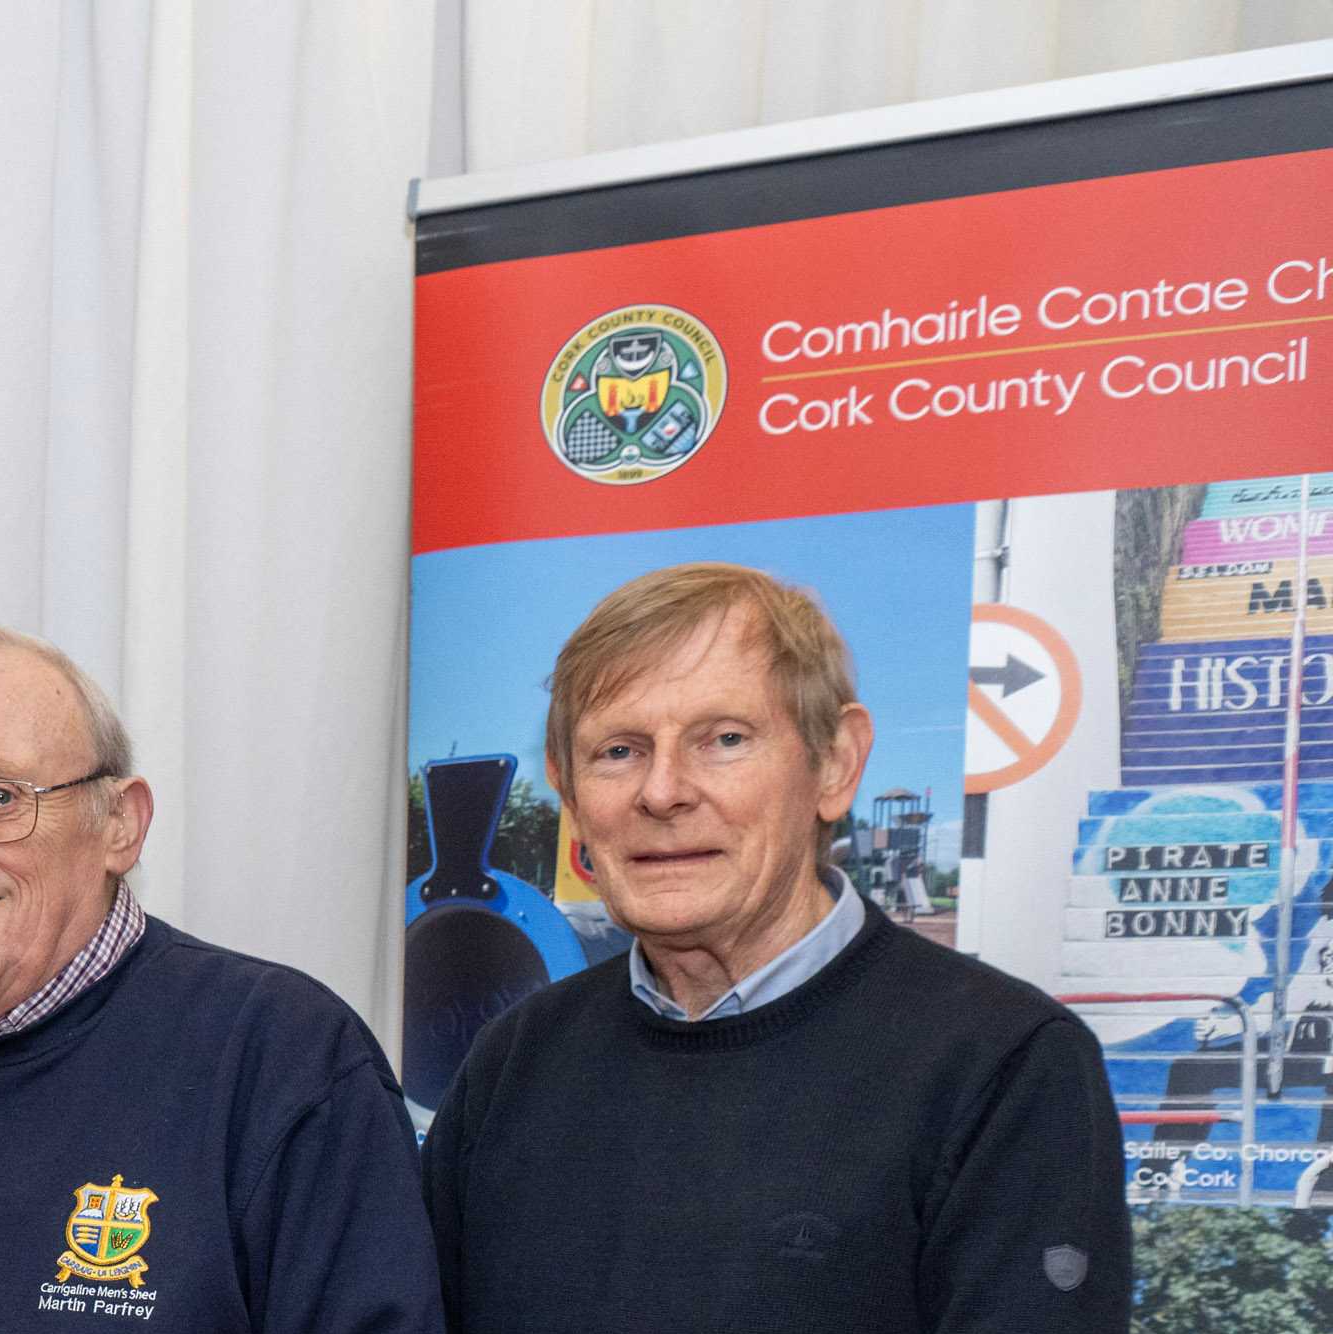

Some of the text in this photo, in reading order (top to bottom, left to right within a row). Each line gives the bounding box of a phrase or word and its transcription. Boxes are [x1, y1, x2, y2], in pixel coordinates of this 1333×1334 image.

[761, 295, 1022, 364] Comhairle
[1037, 277, 1249, 331] Contae
[552, 311, 717, 383] CORK COUNTY COUNCIL
[758, 336, 1309, 437] Cork County Council
[1106, 843, 1269, 870] PIRATE
[1121, 877, 1229, 903] ANNE
[1106, 910, 1248, 937] BONNY
[1193, 1142, 1233, 1161] Co.
[1182, 1168, 1237, 1188] Cork
[40, 1282, 157, 1301] Carrigaline Men's Shed
[38, 1295, 154, 1320] Martin Parfrey
